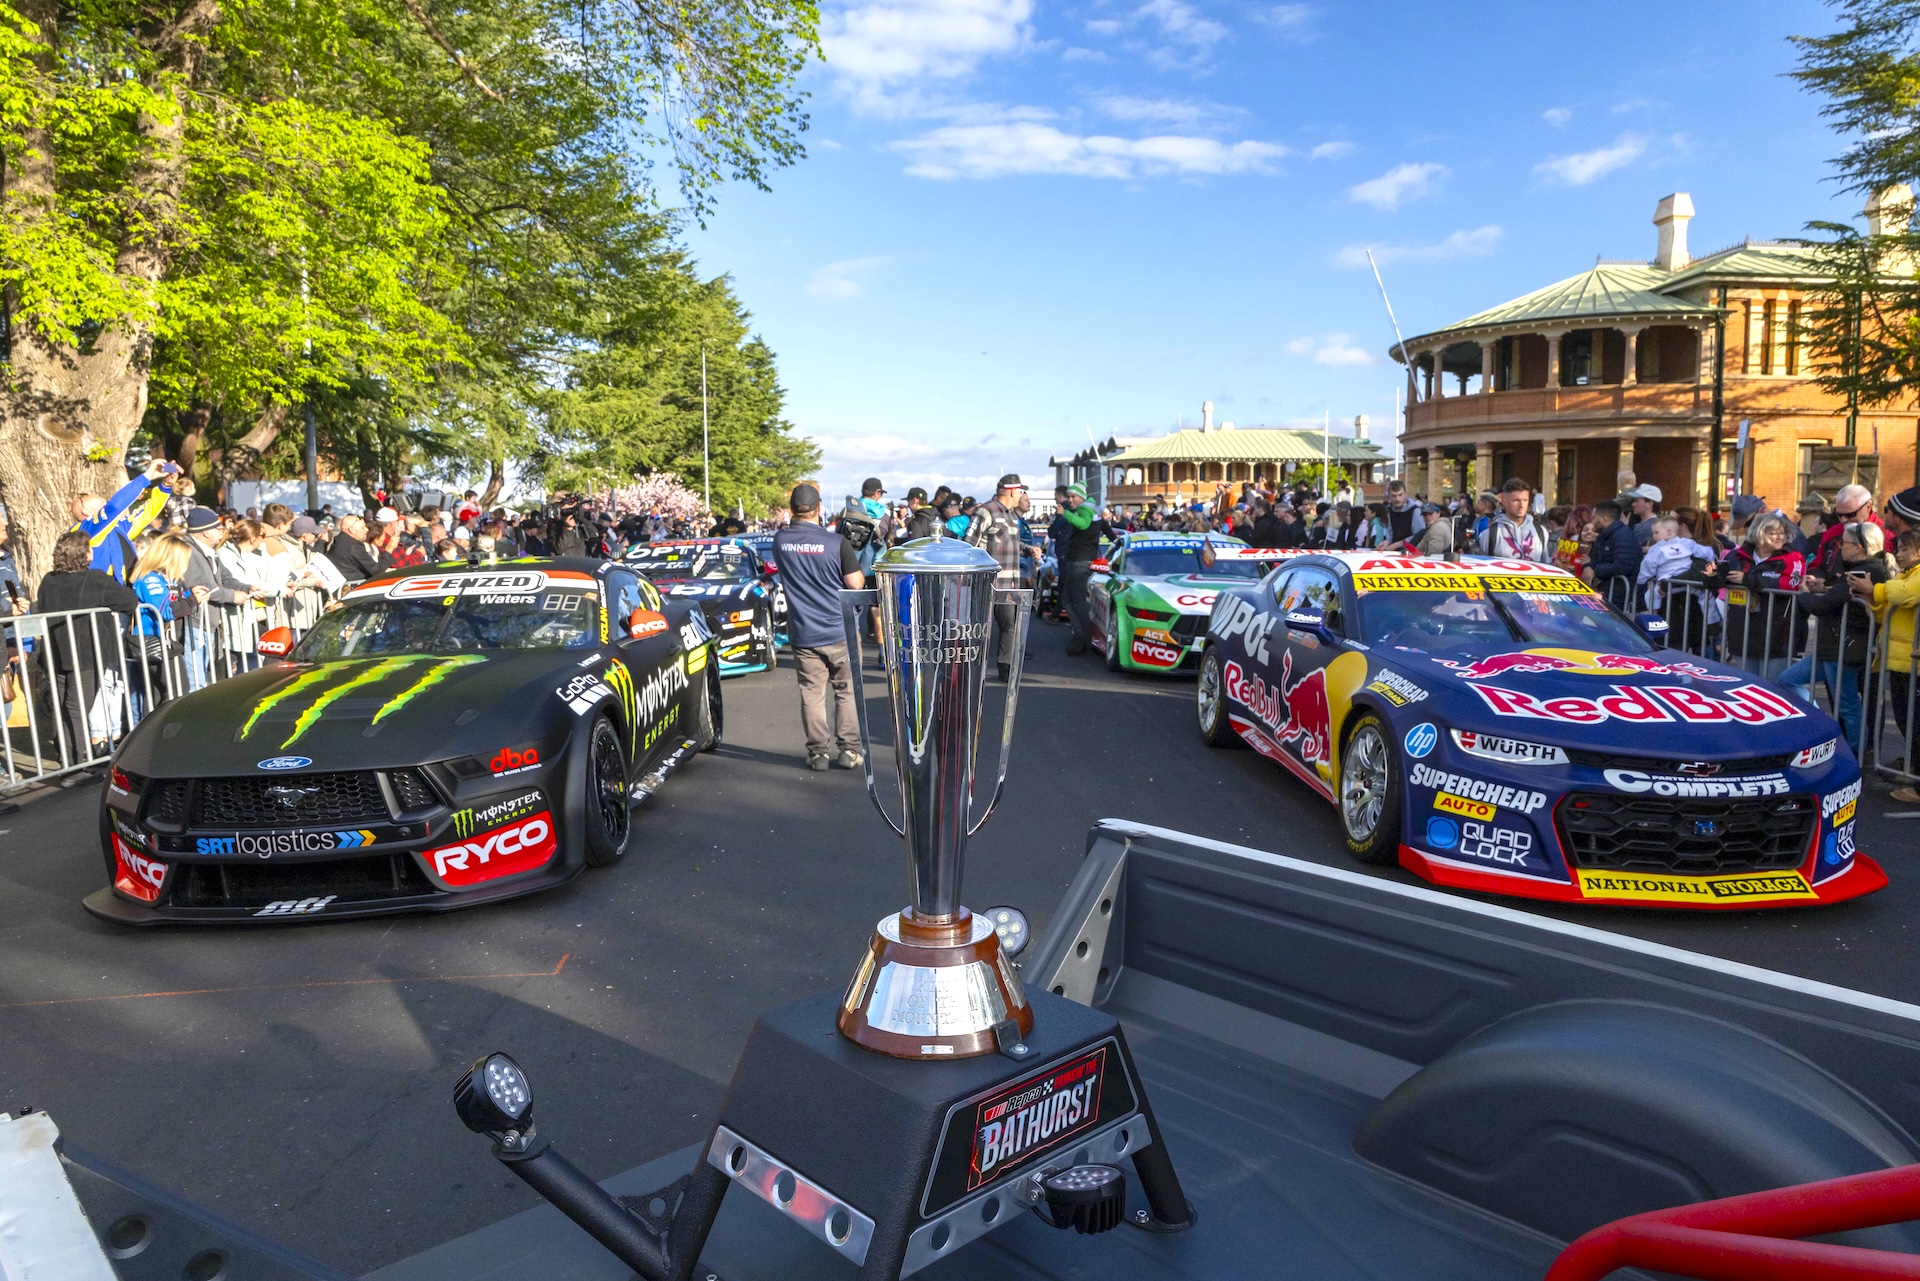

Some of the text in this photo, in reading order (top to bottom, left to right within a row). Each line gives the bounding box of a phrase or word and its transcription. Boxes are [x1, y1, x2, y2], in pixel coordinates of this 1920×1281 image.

[626, 543, 742, 560] OPTUS
[1130, 541, 1203, 549] HERZOG
[1090, 564, 1110, 572] RYCO
[1360, 559, 1566, 575] AMPOL
[1357, 576, 1585, 593] NATIONAL STORAGE
[443, 596, 456, 606] 6
[479, 594, 537, 605] Waters
[1466, 590, 1486, 600] 87
[1517, 592, 1573, 602] Brown
[632, 619, 668, 636] RYCO
[1145, 629, 1165, 641] ACT
[257, 640, 286, 654] RYCO
[1133, 641, 1178, 663] RYCO
[556, 674, 599, 701] GoPro
[636, 654, 690, 728] MONSTER
[1374, 668, 1430, 704] SUPERCHEAP
[643, 703, 681, 750] ENERGY
[1408, 723, 1436, 758] hp
[266, 757, 301, 769] Ford
[490, 747, 539, 773] dba
[521, 763, 543, 773] AUSTRALIA
[1602, 768, 1791, 798] COMPLETE
[1652, 774, 1685, 782] PARTS
[1743, 772, 1784, 782] SOLUTIONS
[1409, 763, 1547, 814] SUPERCHEAP
[475, 790, 542, 822] MONSTER
[1439, 797, 1489, 816] AUTO
[1835, 803, 1855, 823] AUTO
[487, 805, 534, 827] ENERGY
[1462, 821, 1532, 850] QUAD
[434, 819, 549, 877] RYCO
[1460, 838, 1530, 867] LOCK
[117, 839, 168, 889] RYCO
[1585, 877, 1805, 896] NATIONAL STORAGE
[1085, 1058, 1098, 1075] THE
[979, 1074, 1097, 1174] BATHURST
